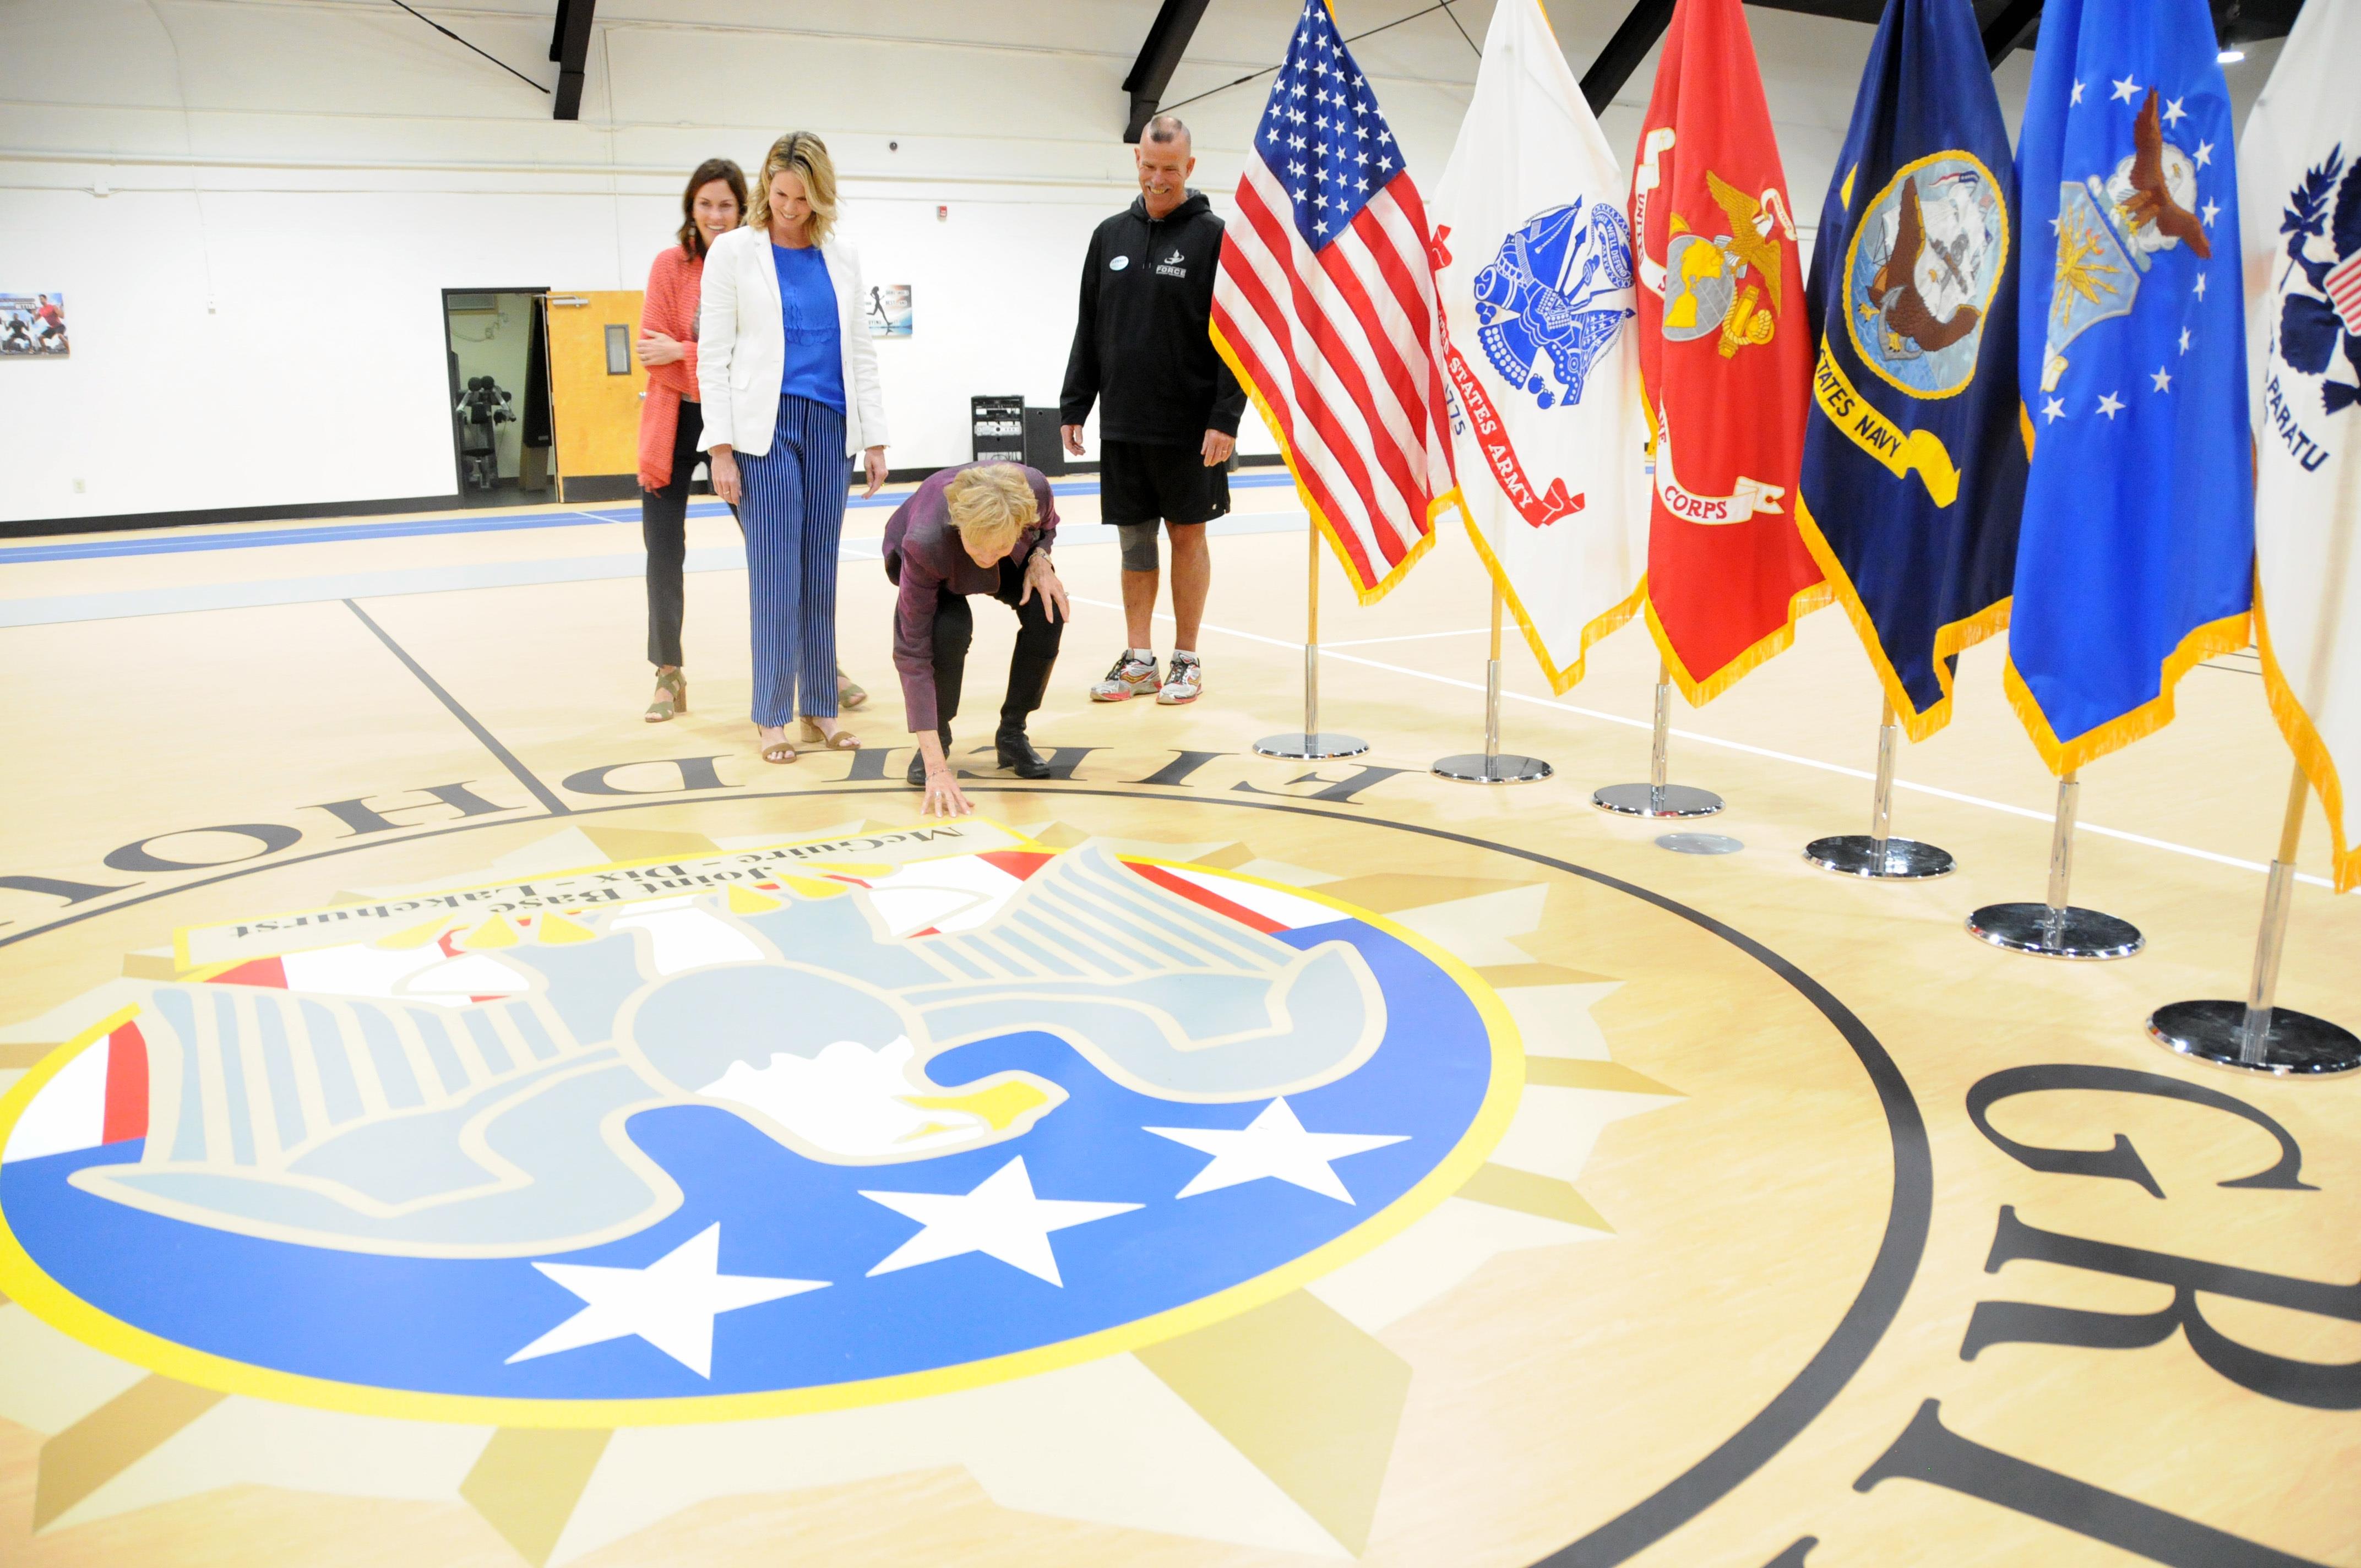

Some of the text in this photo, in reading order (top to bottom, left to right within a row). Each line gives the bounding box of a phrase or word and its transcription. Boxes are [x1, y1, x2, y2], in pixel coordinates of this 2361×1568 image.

[1595, 214, 1628, 277] THIS WE'LL DEFEND
[1156, 266, 1186, 276] FORCE
[1449, 357, 1498, 435] STATES
[1488, 443, 1533, 509] ARMY
[1853, 415, 1901, 458] NAVY
[1665, 486, 1727, 519] CORPS
[738, 827, 965, 863] McGuire
[489, 866, 772, 913] Joint Base
[593, 864, 689, 884] Dix
[230, 885, 537, 939] Lakehurst
[1764, 1064, 2361, 1568] GRI
